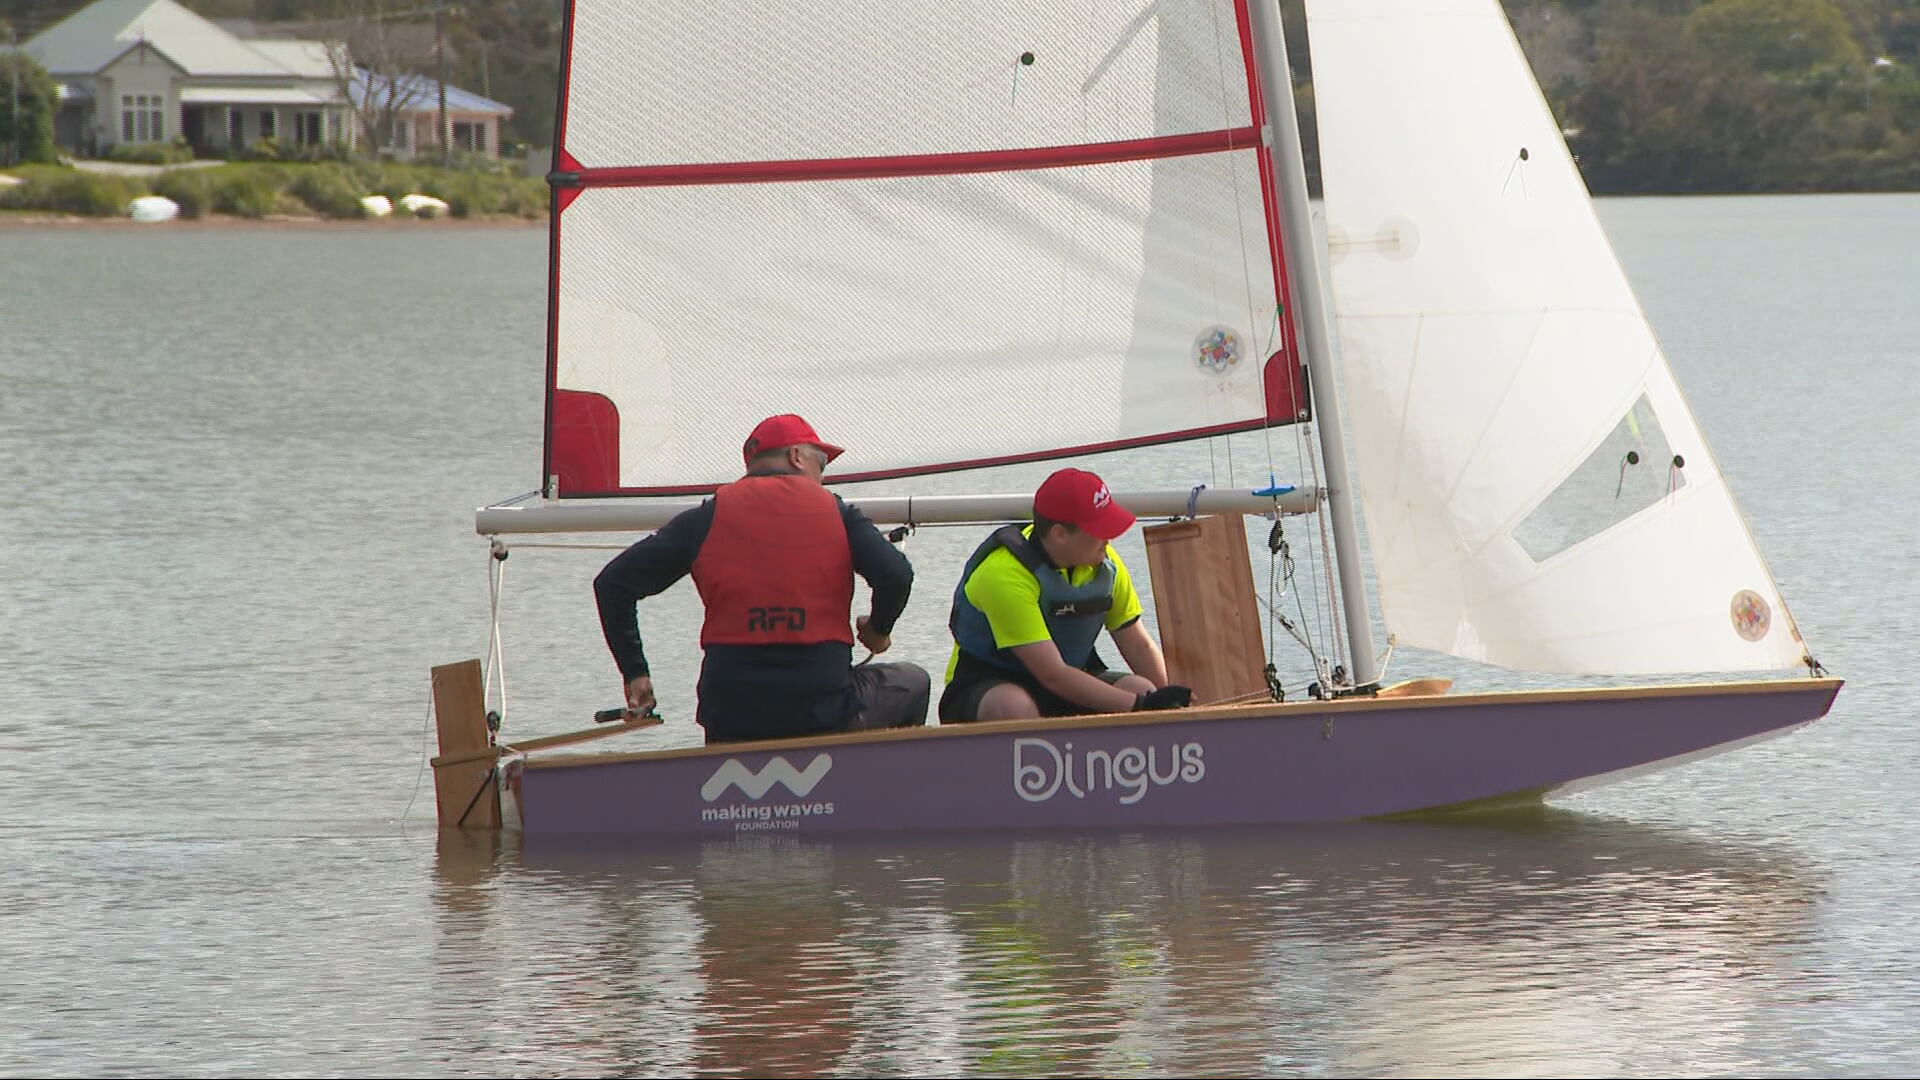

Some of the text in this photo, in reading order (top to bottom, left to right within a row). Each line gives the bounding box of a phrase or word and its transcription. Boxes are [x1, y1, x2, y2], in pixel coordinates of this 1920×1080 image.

[747, 607, 807, 633] RFD
[1013, 738, 1206, 804] Dingus
[701, 801, 834, 821] making waves
[735, 819, 800, 832] FOUNDATION
